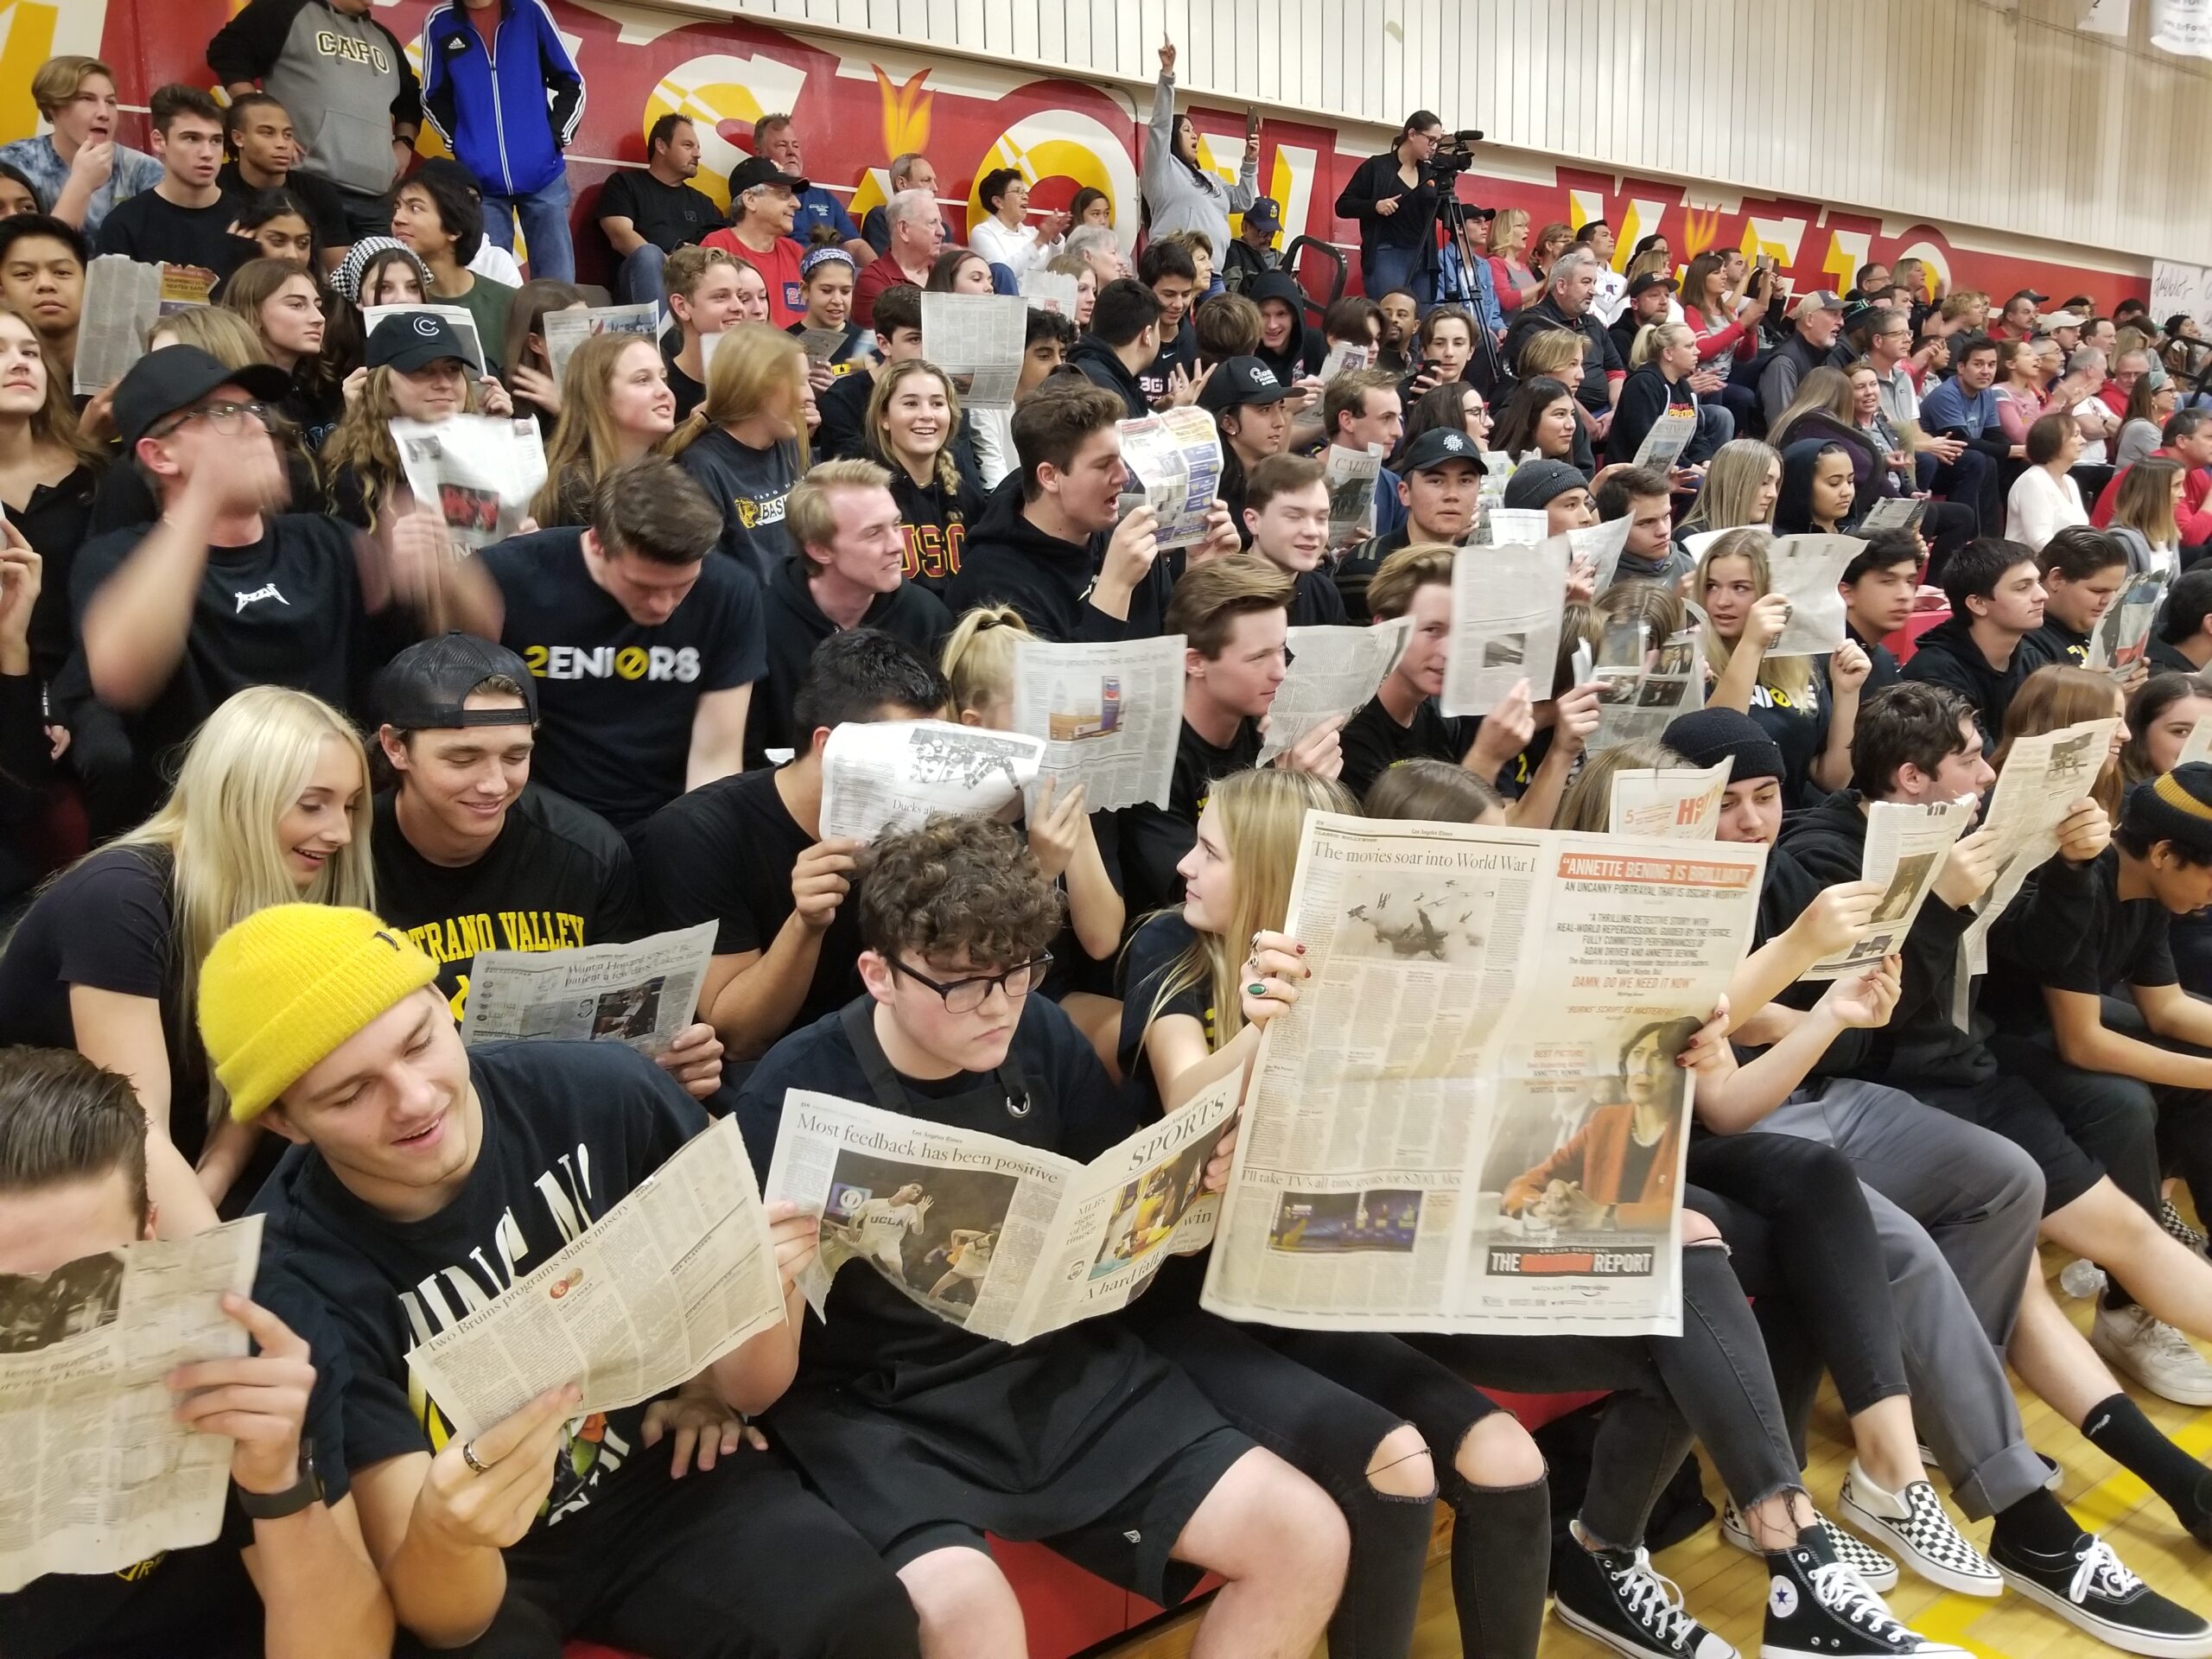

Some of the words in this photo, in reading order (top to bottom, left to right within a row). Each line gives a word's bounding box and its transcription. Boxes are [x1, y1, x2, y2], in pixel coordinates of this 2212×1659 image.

[315, 30, 390, 74] CAPO
[413, 315, 440, 336] C
[754, 490, 778, 500] CAPO
[893, 798, 922, 813] Ducks
[1313, 840, 1342, 861] The
[1346, 848, 1391, 864] movies
[1394, 851, 1423, 865] soar
[1426, 850, 1453, 868] into
[1457, 853, 1497, 870] World
[1500, 855, 1528, 873] War
[1529, 857, 1536, 873] I
[1625, 861, 1671, 880] BENING
[1673, 864, 1686, 880] IS
[1688, 866, 1751, 884] BRILLIANT
[1564, 881, 1575, 891] AN
[1577, 882, 1611, 893] UNCANNY
[1613, 884, 1656, 896] PORTRAYAL
[1658, 887, 1675, 896] THAT
[1599, 913, 1631, 924] THRILLING
[1633, 915, 1669, 925] DETECTIVE
[1669, 917, 1691, 925] STORY
[1556, 923, 1601, 933] REAL-WORLD
[406, 913, 497, 964] TRANO
[499, 912, 585, 951] VALLEY
[1582, 935, 1602, 944] FULLY
[1645, 938, 1700, 947] PERFORMANCES
[1585, 947, 1603, 956] ADAM
[1605, 947, 1629, 957] DRIVER
[1631, 948, 1644, 957] AND
[1645, 948, 1674, 957] ANNETTE
[569, 964, 595, 975] Want
[565, 972, 601, 988] patient
[1604, 976, 1616, 988] DO
[1618, 976, 1632, 988] WE
[1636, 977, 1659, 988] NEED
[1598, 1006, 1624, 1014] SCRIPT
[924, 1132, 944, 1141] Angeles
[1128, 1092, 1227, 1172] SPORTS
[796, 1113, 841, 1138] Most
[843, 1125, 916, 1157] feedback
[921, 1142, 948, 1161] has
[951, 1147, 992, 1167] been
[994, 1155, 1059, 1185] positive
[1259, 1173, 1282, 1185] take
[870, 1216, 904, 1227] UCLA
[1491, 1253, 1521, 1273] THE
[1593, 1253, 1652, 1273] REPORT
[425, 1332, 457, 1352] Two
[456, 1306, 502, 1335] Bruins
[503, 1262, 561, 1308] programs
[560, 1236, 593, 1263] share
[594, 1203, 631, 1239] misery
[1079, 1287, 1093, 1302] A
[1099, 1268, 1136, 1295] hard
[576, 1282, 594, 1298] UCLA
